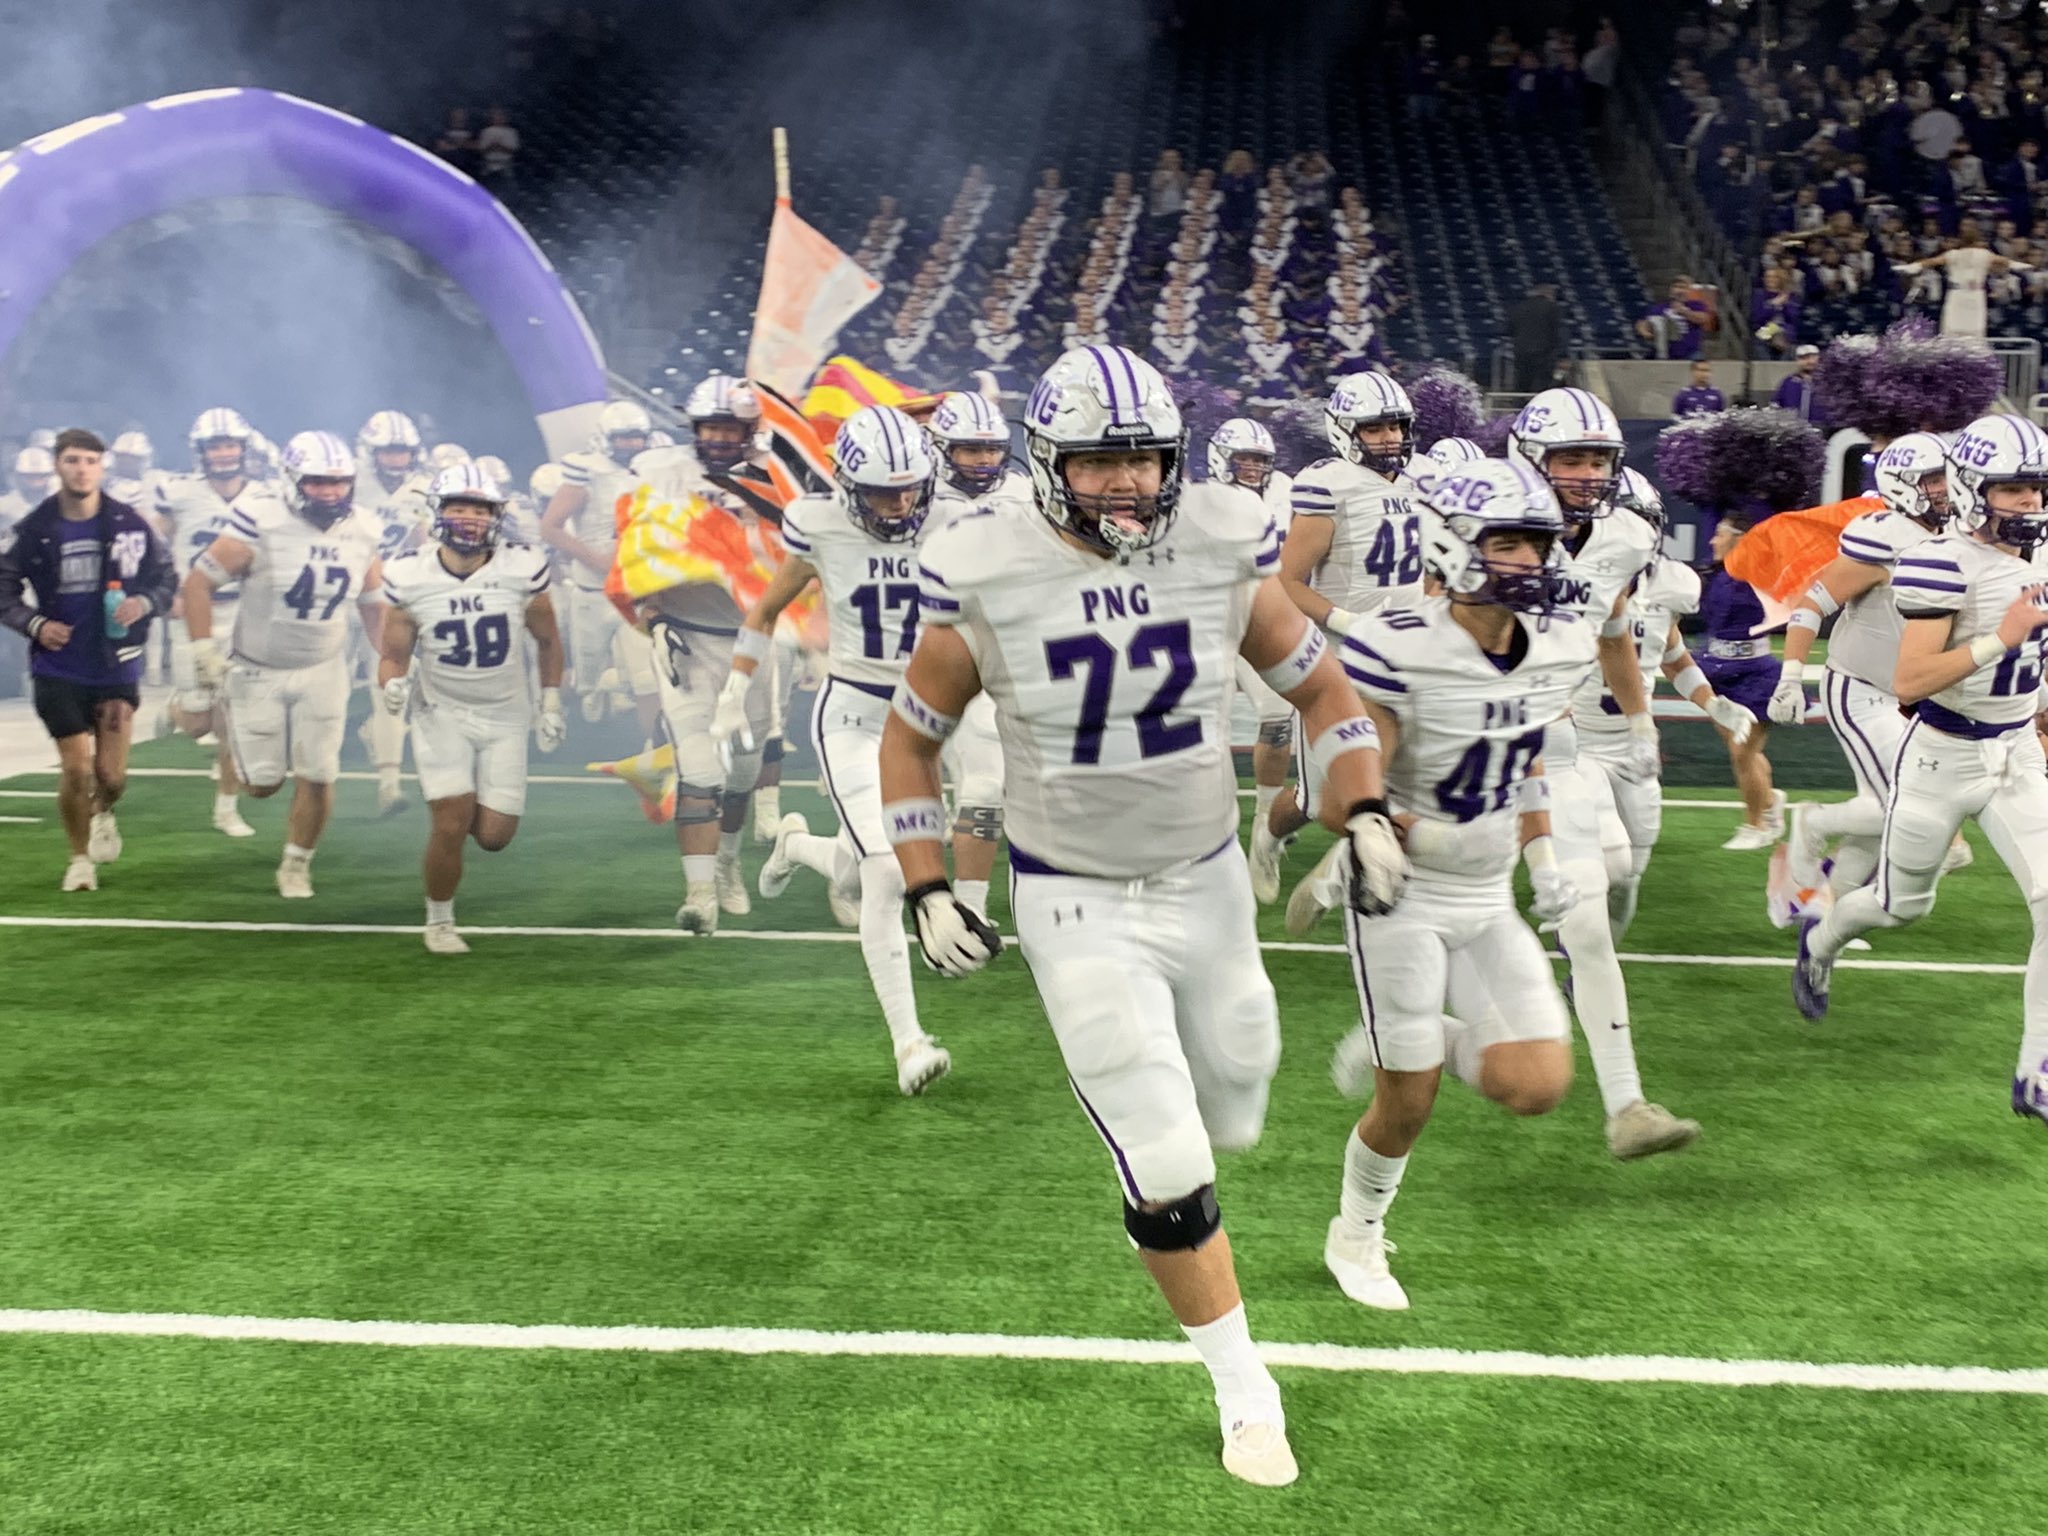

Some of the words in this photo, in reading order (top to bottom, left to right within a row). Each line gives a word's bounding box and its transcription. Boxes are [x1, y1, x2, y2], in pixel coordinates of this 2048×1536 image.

[1879, 447, 1916, 468] PNG
[1953, 432, 1997, 467] PNG
[1382, 498, 1412, 514] PNG
[310, 546, 340, 561] PNG
[868, 557, 909, 579] PNG
[1364, 515, 1423, 587] 48
[283, 563, 351, 620] 47
[449, 595, 485, 616] PNG
[1080, 583, 1152, 623] PNG
[433, 613, 511, 668] 38
[850, 583, 920, 660] 17
[1042, 618, 1204, 765] 72
[1433, 725, 1546, 824] 40
